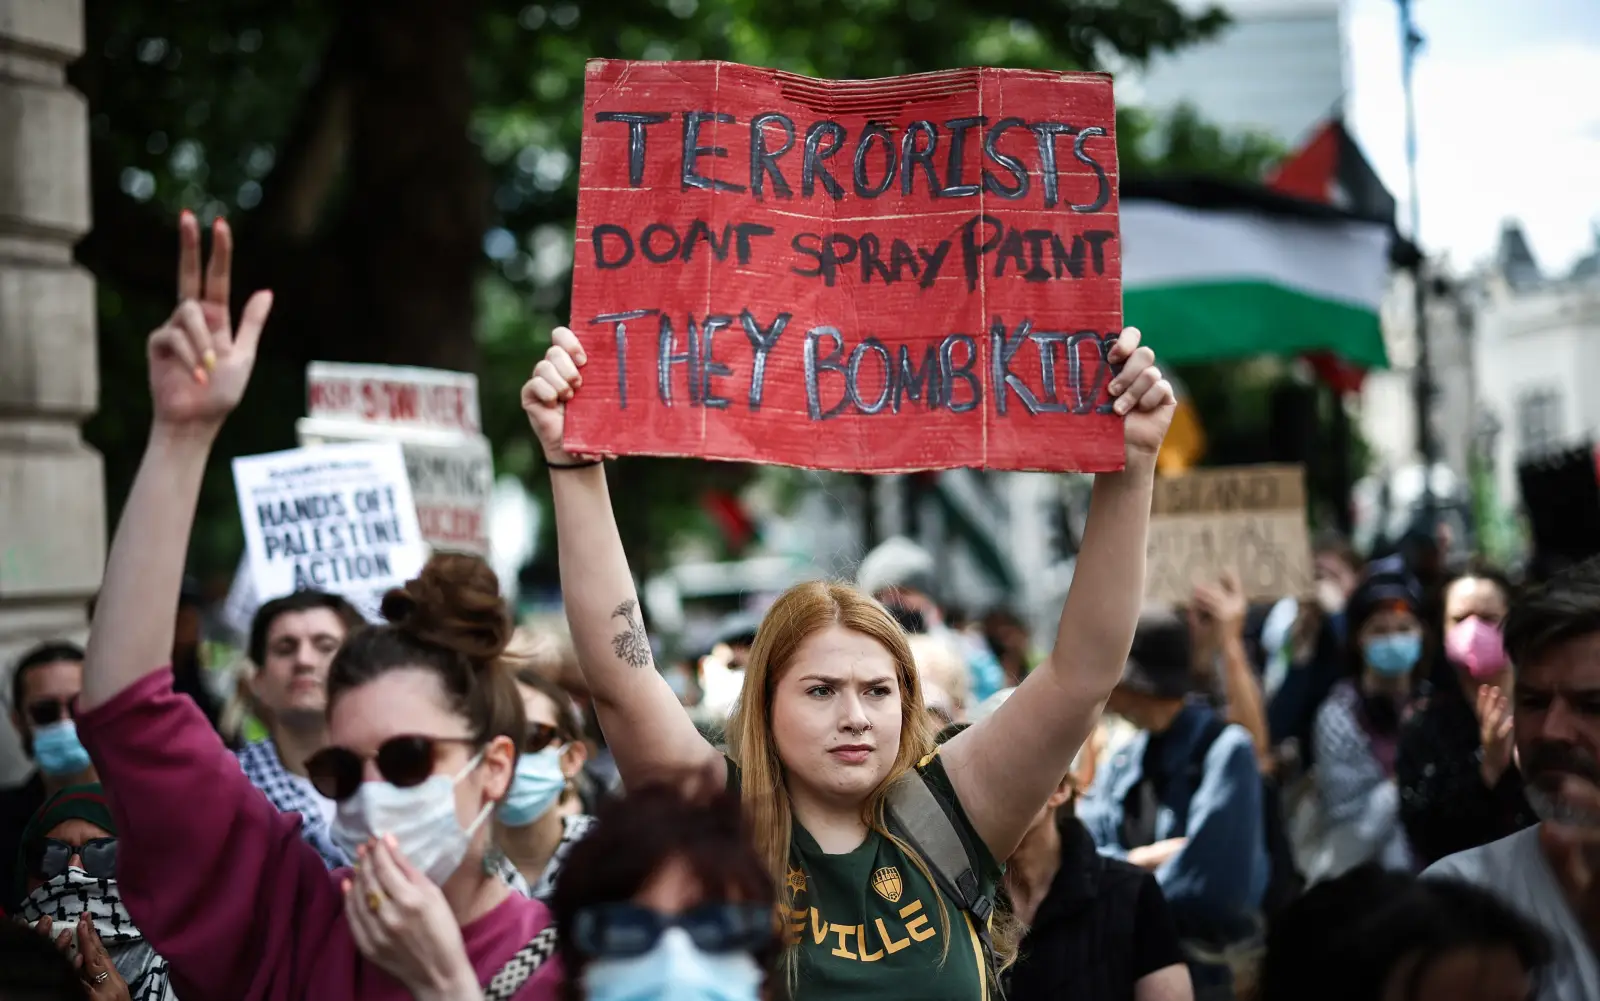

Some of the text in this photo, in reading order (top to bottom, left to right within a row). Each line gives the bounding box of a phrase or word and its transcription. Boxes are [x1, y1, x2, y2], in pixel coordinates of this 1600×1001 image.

[595, 110, 1112, 213] TERRORISTS
[591, 214, 1114, 293] DONT SPRAY PAINT
[588, 308, 793, 411] THEY
[803, 325, 983, 421] BOMB
[257, 493, 346, 528] HANDS
[264, 517, 404, 560] PALESTINE
[294, 553, 392, 591] ACTION
